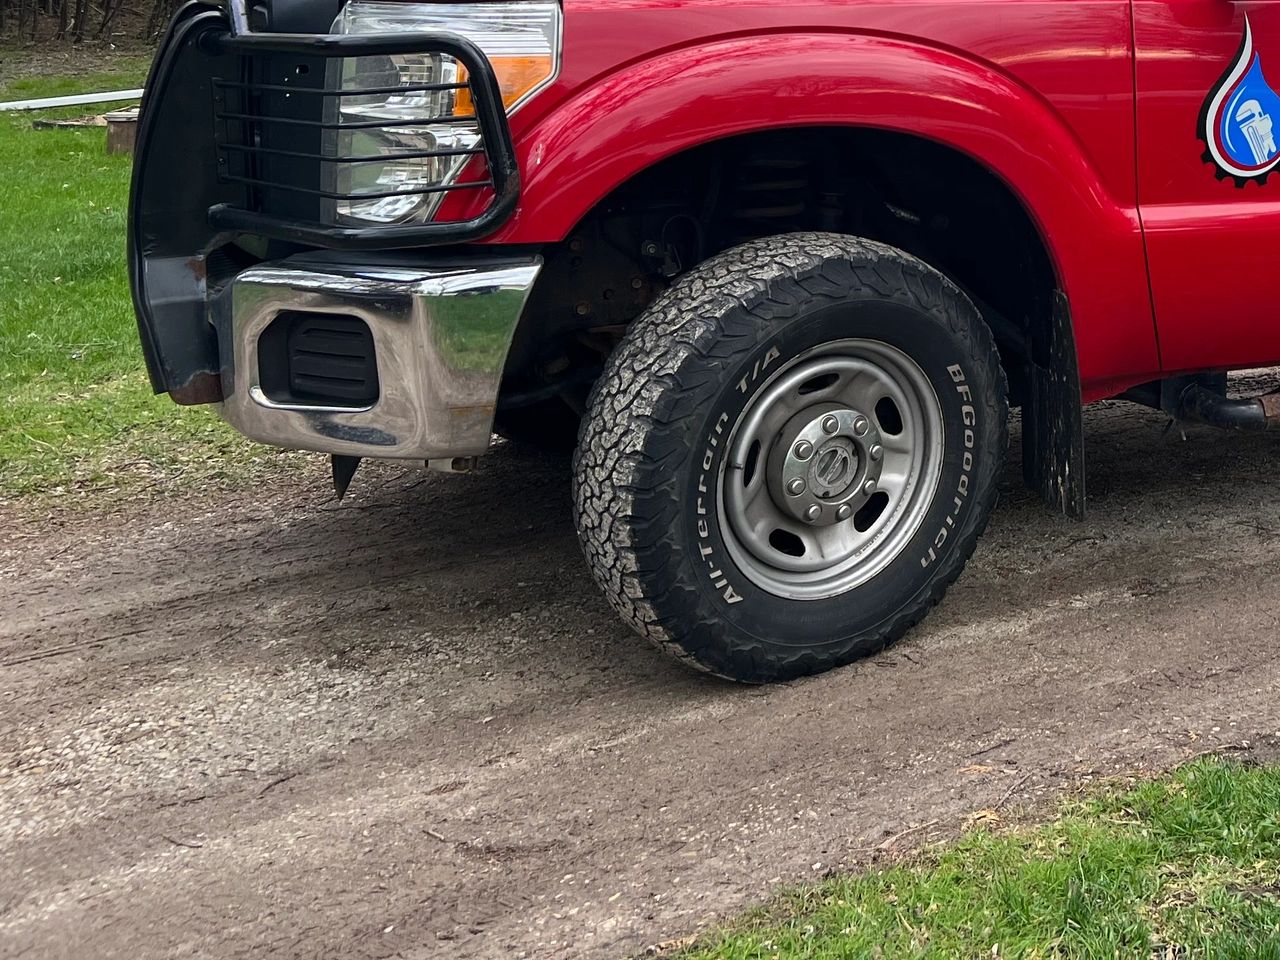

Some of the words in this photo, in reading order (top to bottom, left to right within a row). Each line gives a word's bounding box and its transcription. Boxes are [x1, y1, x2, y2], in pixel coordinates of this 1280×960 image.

[697, 411, 744, 604] All-Terrain
[735, 344, 781, 394] T/A
[920, 363, 976, 568] BFGoodrich
